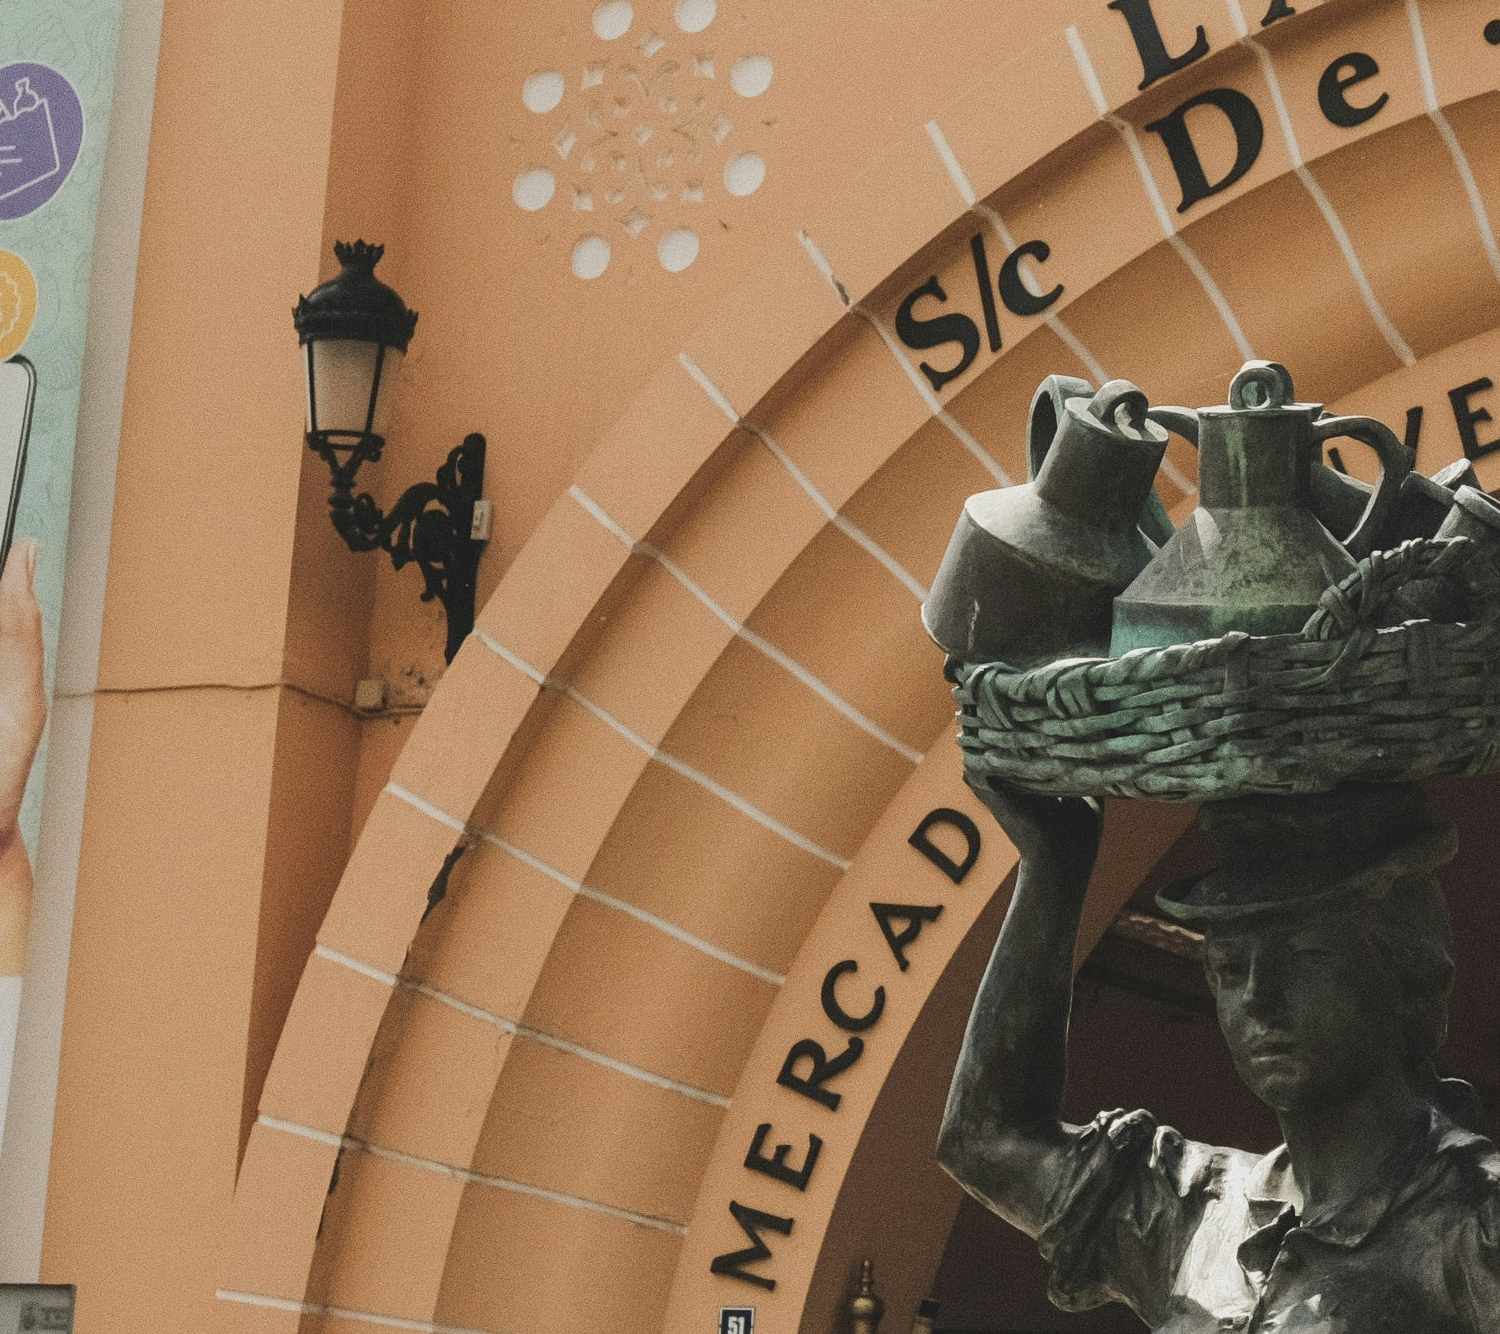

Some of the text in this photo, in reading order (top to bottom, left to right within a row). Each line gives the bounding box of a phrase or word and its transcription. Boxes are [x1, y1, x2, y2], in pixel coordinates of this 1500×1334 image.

[894, 234, 1065, 392] S/c
[1145, 47, 1390, 213] De
[709, 807, 982, 1292] MERCAD
